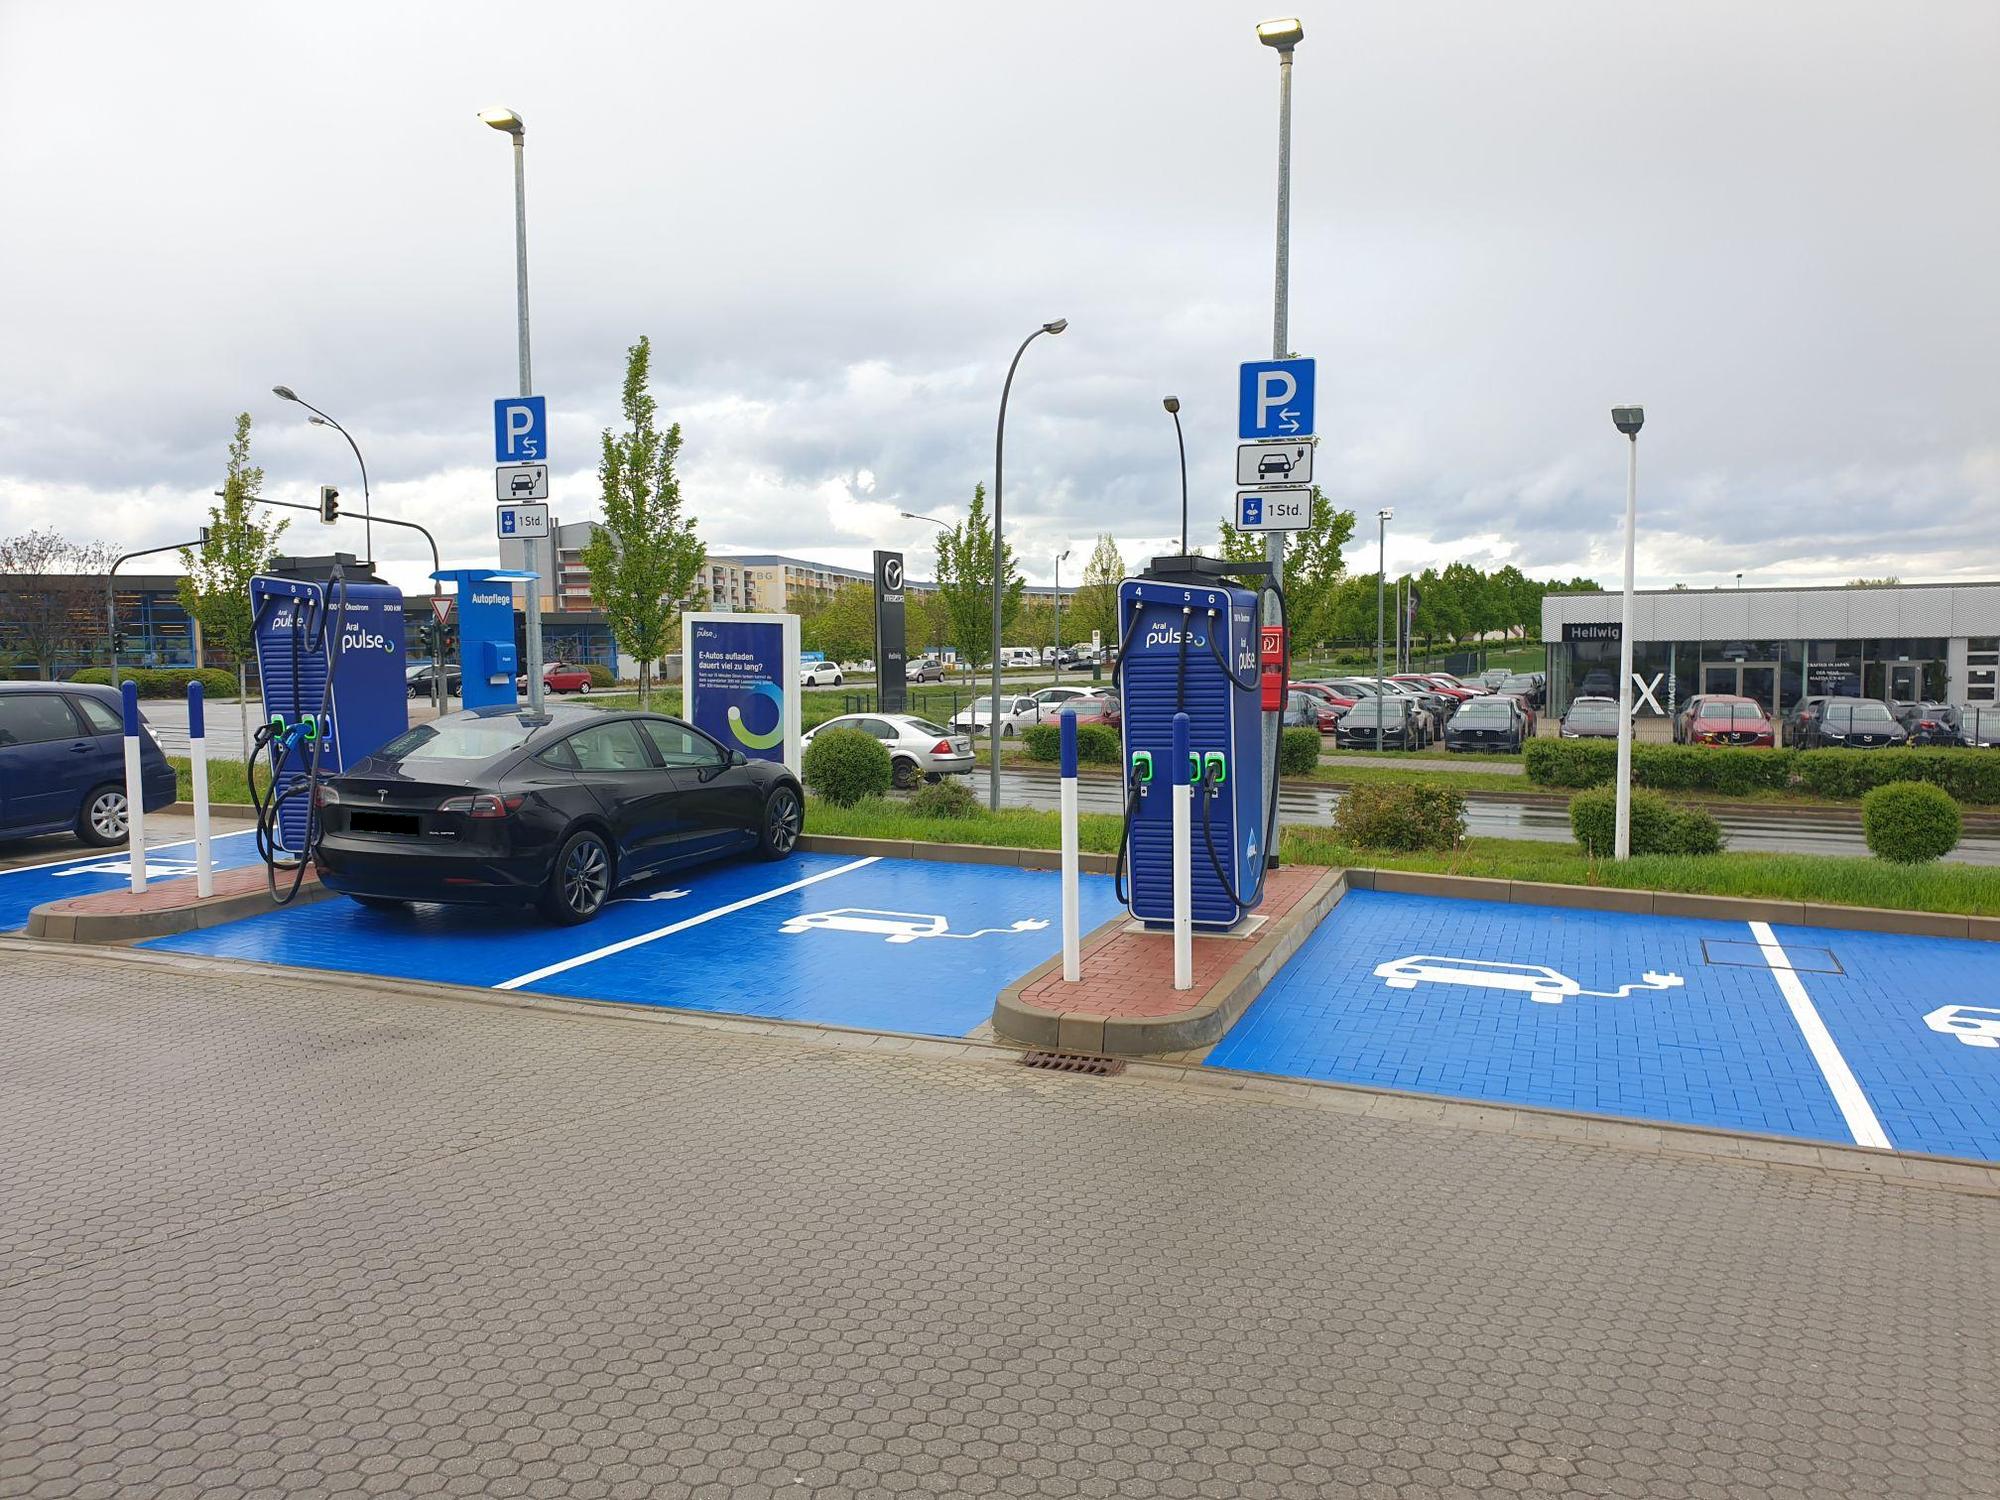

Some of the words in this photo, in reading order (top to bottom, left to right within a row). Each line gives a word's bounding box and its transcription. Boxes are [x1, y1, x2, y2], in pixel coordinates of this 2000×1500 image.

[1256, 370, 1297, 429] P
[506, 405, 534, 454] P
[1268, 504, 1273, 516] 1
[1277, 503, 1302, 516] Std.
[519, 516, 523, 526] 1
[525, 516, 542, 526] Std.
[290, 585, 296, 593] 8
[306, 588, 312, 596] 9
[1135, 587, 1142, 596] 4
[472, 593, 510, 606] Autopflege
[1184, 592, 1191, 601] 5
[1208, 594, 1215, 604] 6
[346, 622, 359, 632] Aral
[1152, 622, 1167, 630] Aral
[1145, 627, 1194, 649] pulse
[1571, 626, 1620, 640] Hellwig
[342, 629, 384, 654] pulse
[698, 651, 724, 660] E-Autos
[725, 652, 754, 661] aufladen
[1238, 645, 1256, 677] pulse
[698, 661, 720, 670] dauert
[721, 662, 733, 670] viel
[743, 663, 763, 673] lang?
